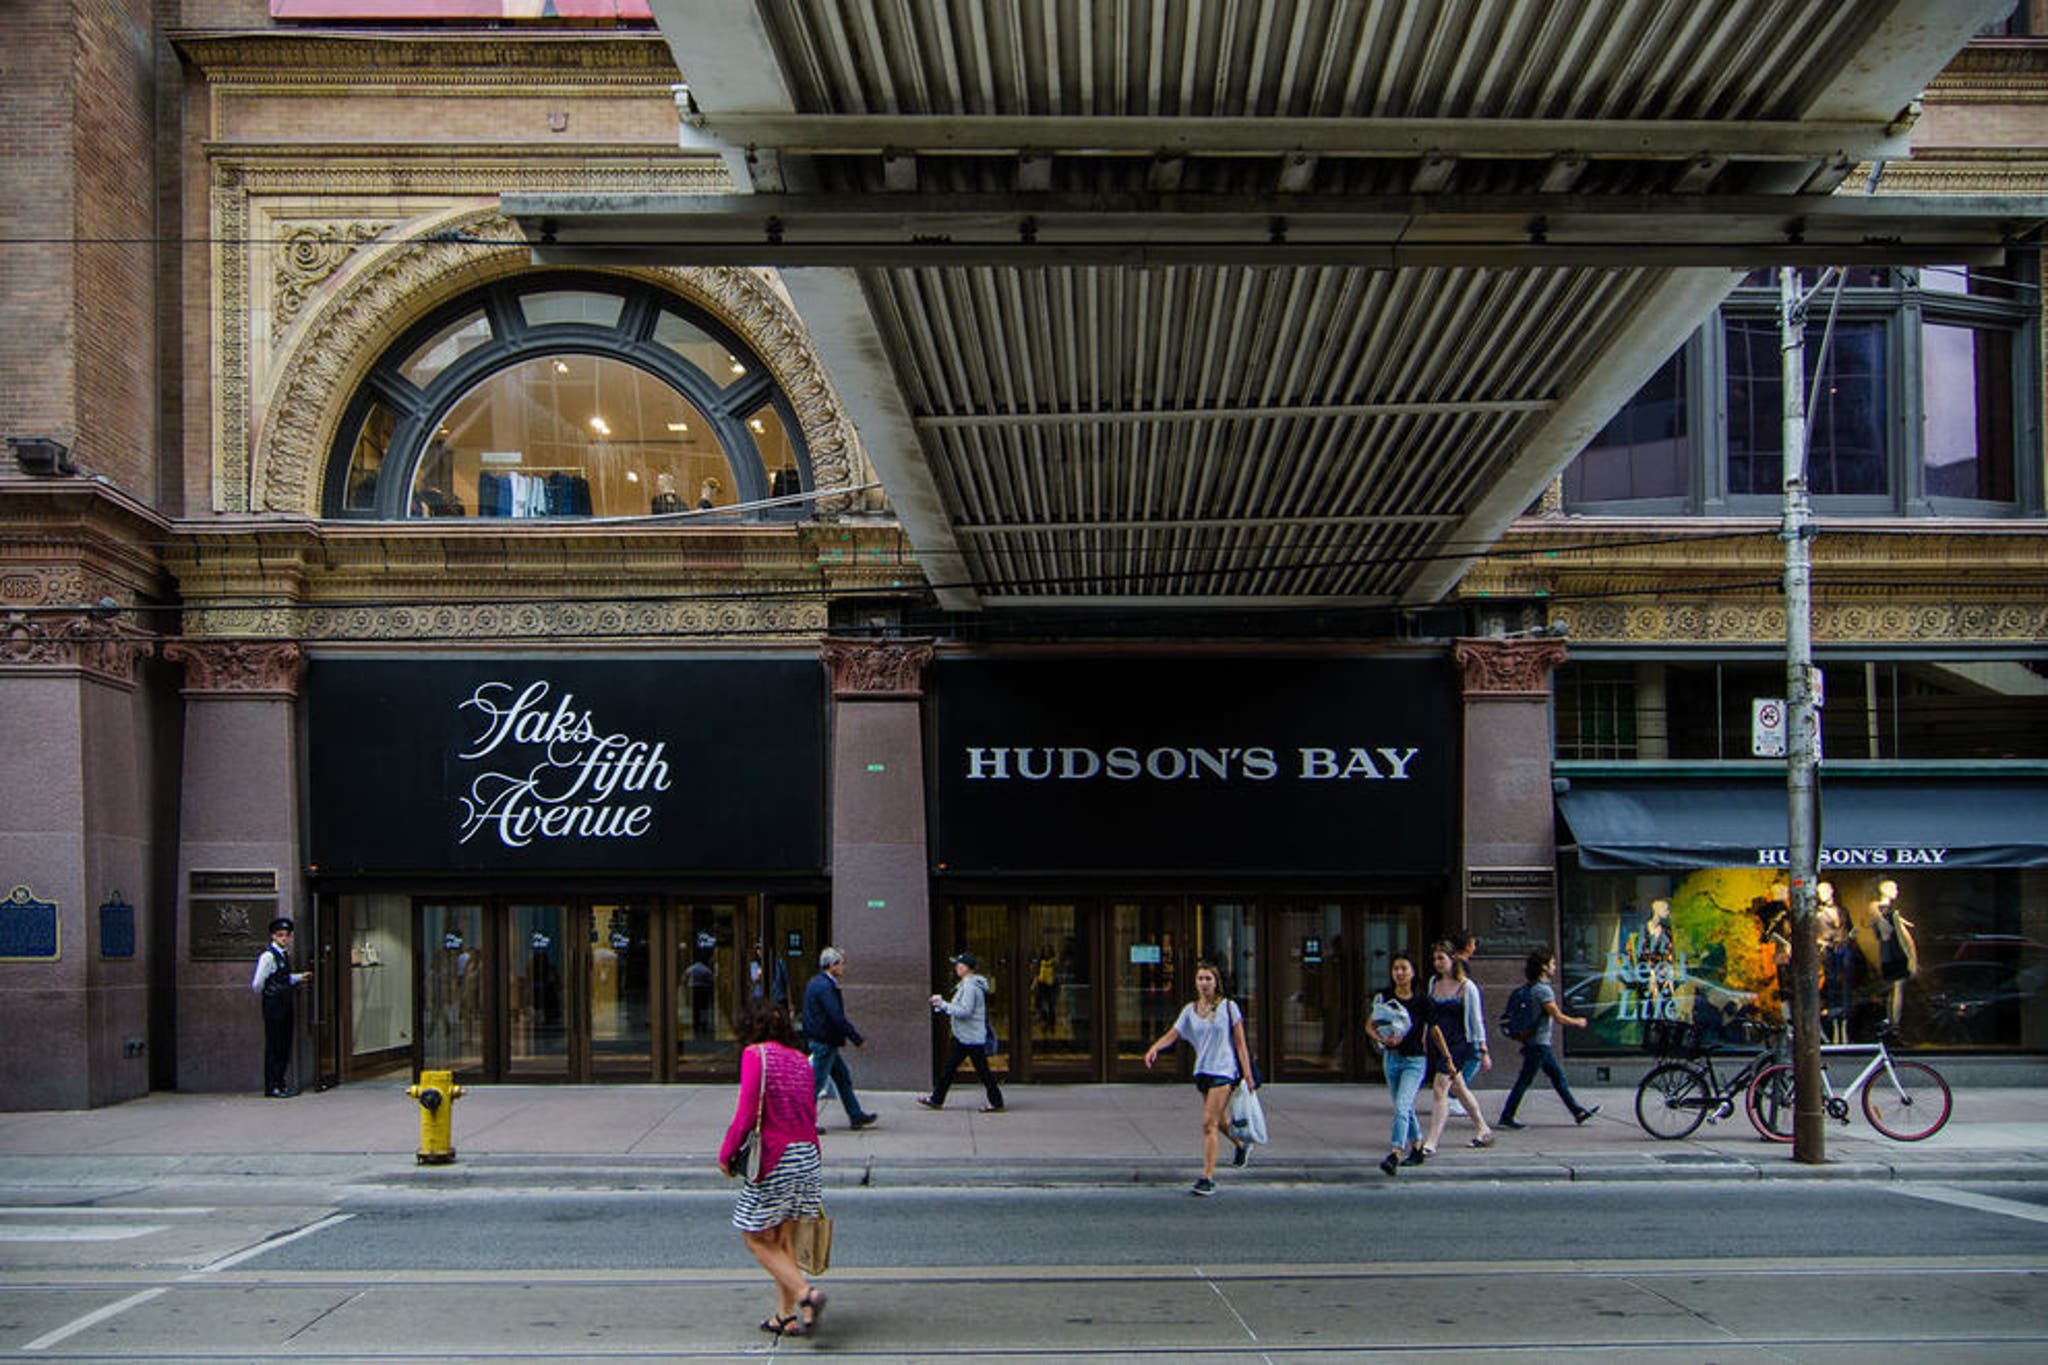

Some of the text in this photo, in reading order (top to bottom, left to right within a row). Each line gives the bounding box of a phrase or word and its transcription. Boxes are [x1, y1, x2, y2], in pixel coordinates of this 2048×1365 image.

[458, 681, 594, 760] Saks
[966, 748, 1418, 779] HUDSON'S BAY
[459, 773, 652, 847] Avenue
[1757, 849, 1947, 864] HUSON'S BAY
[1606, 952, 1688, 984] Real
[1617, 986, 1681, 1021] Life
